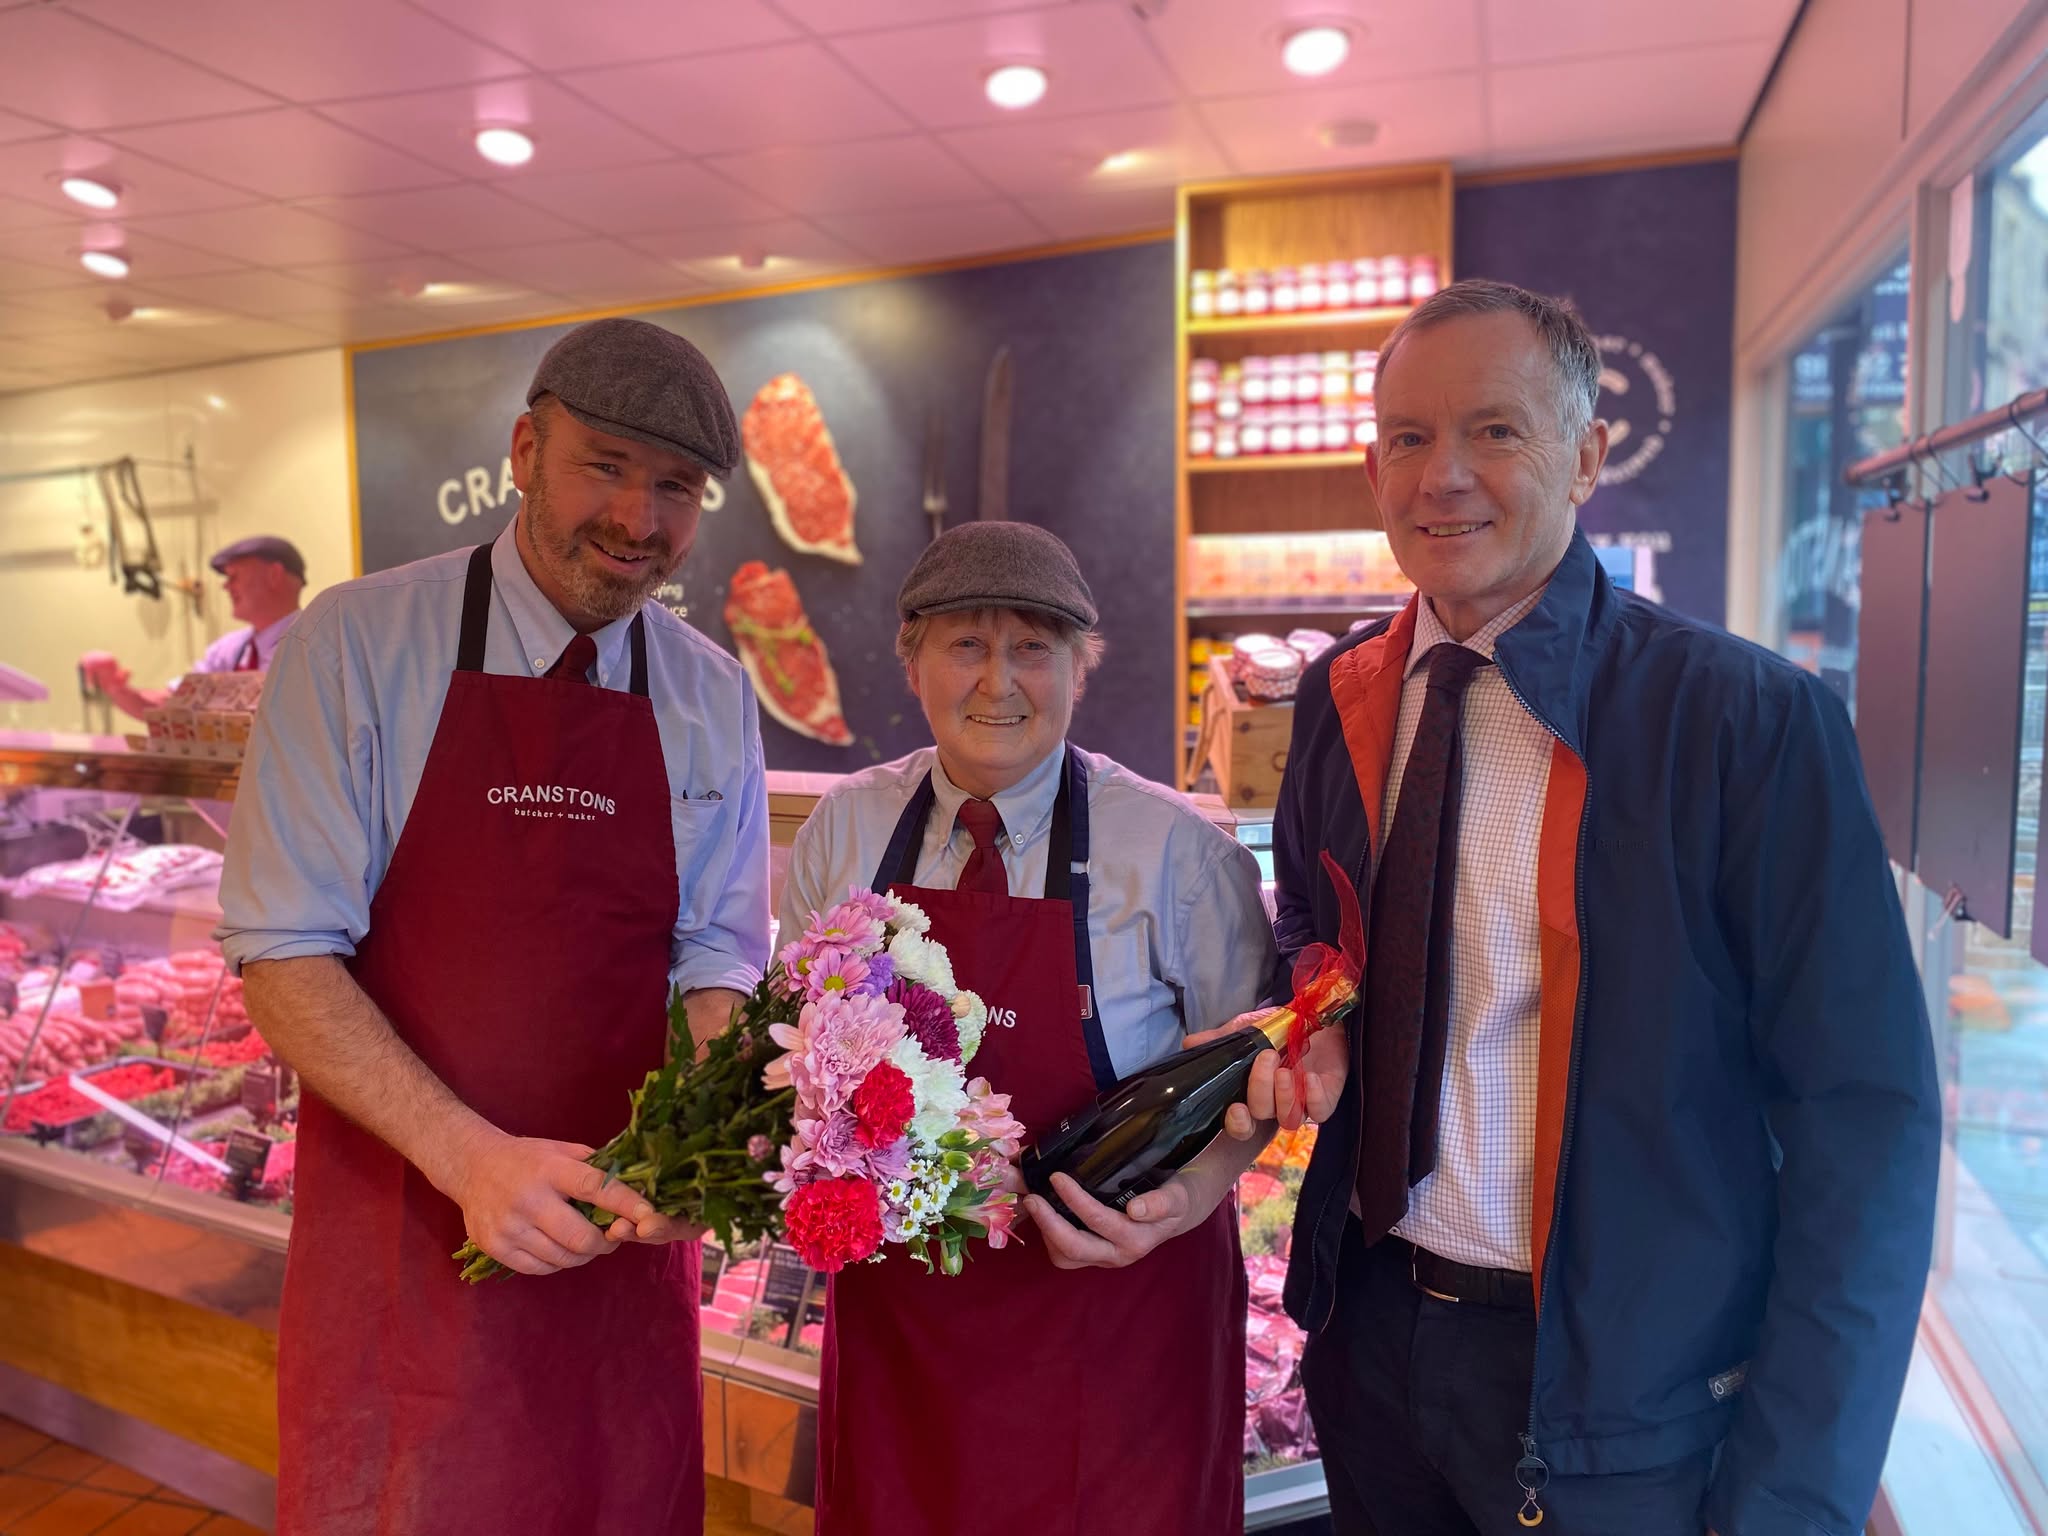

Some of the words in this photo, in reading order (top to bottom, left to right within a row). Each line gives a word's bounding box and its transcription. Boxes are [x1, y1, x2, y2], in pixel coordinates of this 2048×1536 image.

[487, 785, 616, 815] CRANSTONS
[514, 808, 554, 818] butcher
[567, 812, 596, 821] maker
